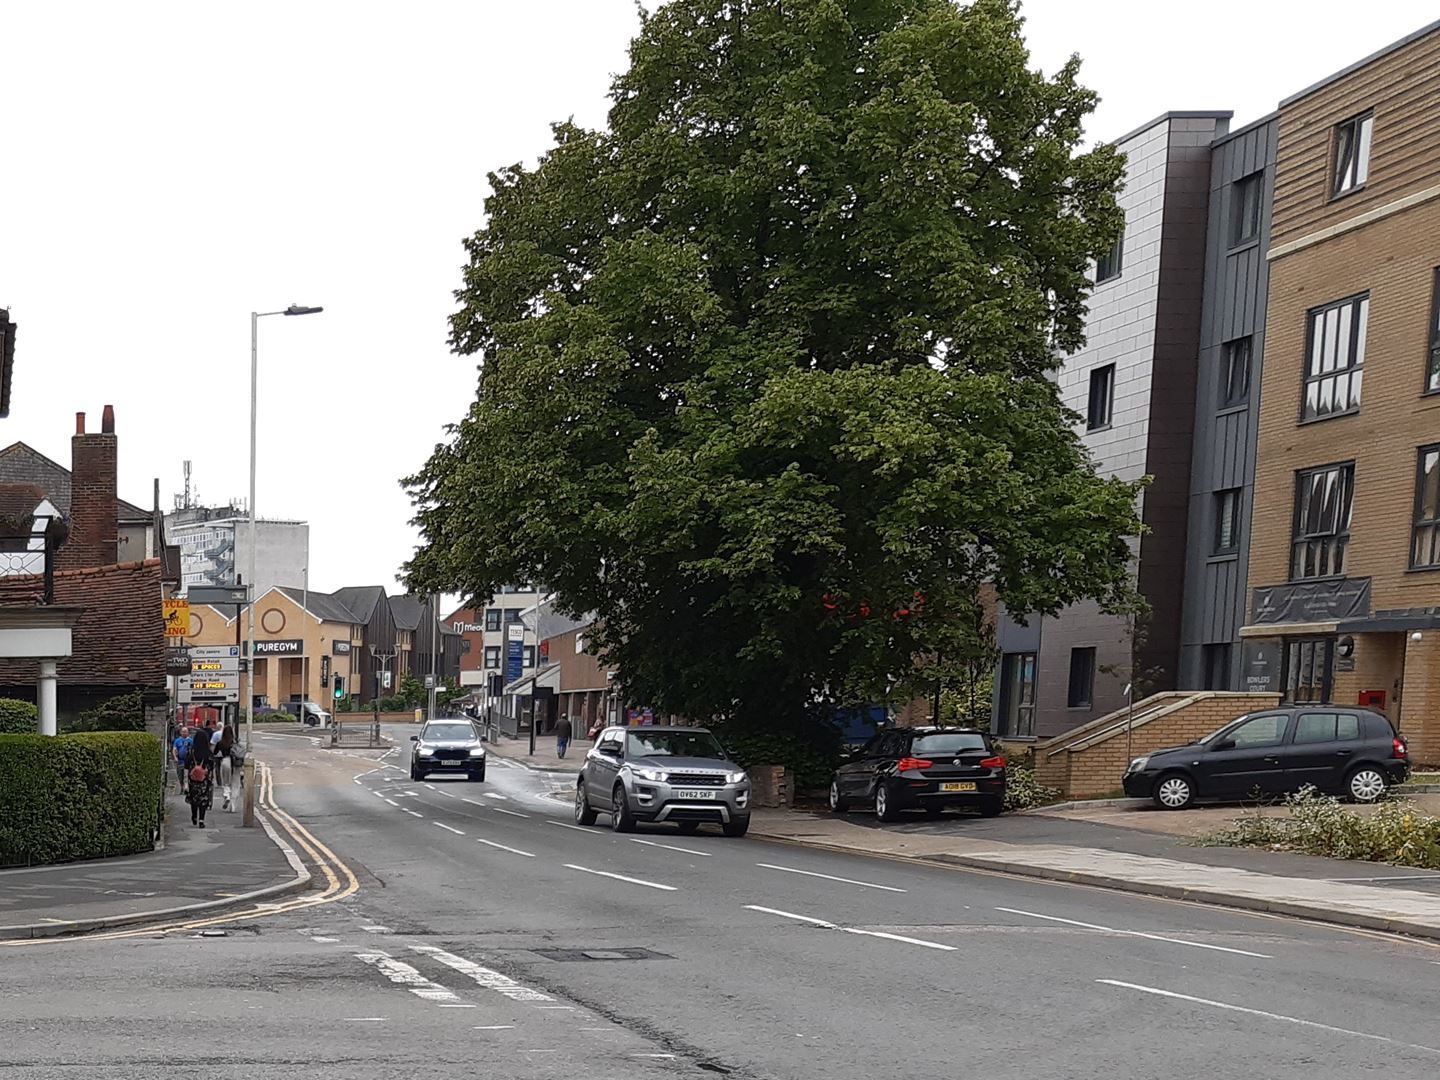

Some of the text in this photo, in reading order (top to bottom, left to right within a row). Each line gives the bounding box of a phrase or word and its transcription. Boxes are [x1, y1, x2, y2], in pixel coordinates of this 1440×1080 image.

[163, 600, 189, 608] YCLE
[164, 627, 187, 635] ING
[257, 642, 298, 652] PUREGYM
